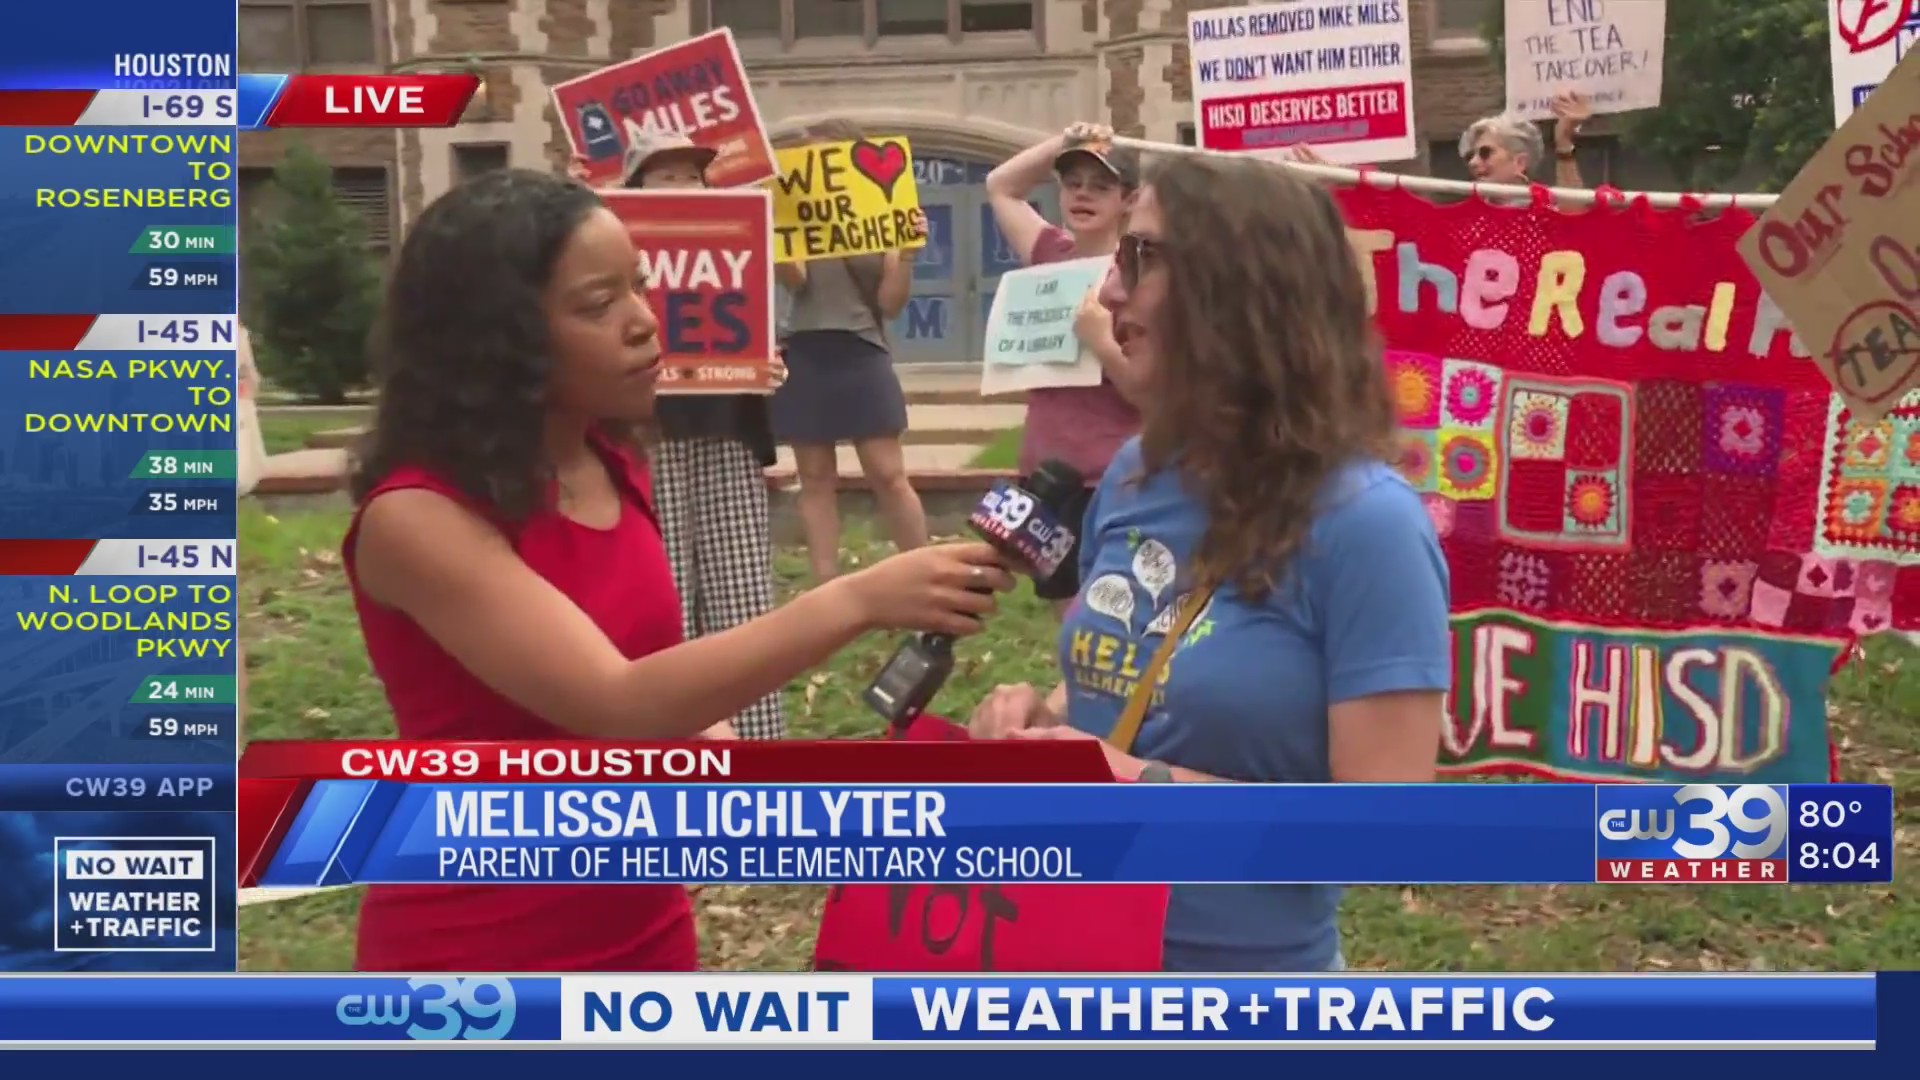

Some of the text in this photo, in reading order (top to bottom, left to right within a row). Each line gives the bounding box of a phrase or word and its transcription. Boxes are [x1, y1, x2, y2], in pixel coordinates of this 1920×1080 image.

[1193, 0, 1404, 41] DALLAS REMOVED MIKE MILES.
[1548, 0, 1605, 26] END
[1524, 24, 1624, 54] THE TEA
[1200, 60, 1221, 82] WE
[1225, 53, 1267, 80] DON'T
[1272, 50, 1313, 76] WANT
[1317, 47, 1346, 71] HIM
[622, 85, 740, 142] MILES
[1208, 89, 1398, 129] HISD DESERVES BETTER
[777, 148, 845, 195] WE
[798, 195, 857, 222] OUR
[774, 207, 928, 257] TEACHERS
[1758, 184, 1852, 278] Our
[1836, 311, 1920, 388] TEA
[1570, 642, 1789, 770] HISD
